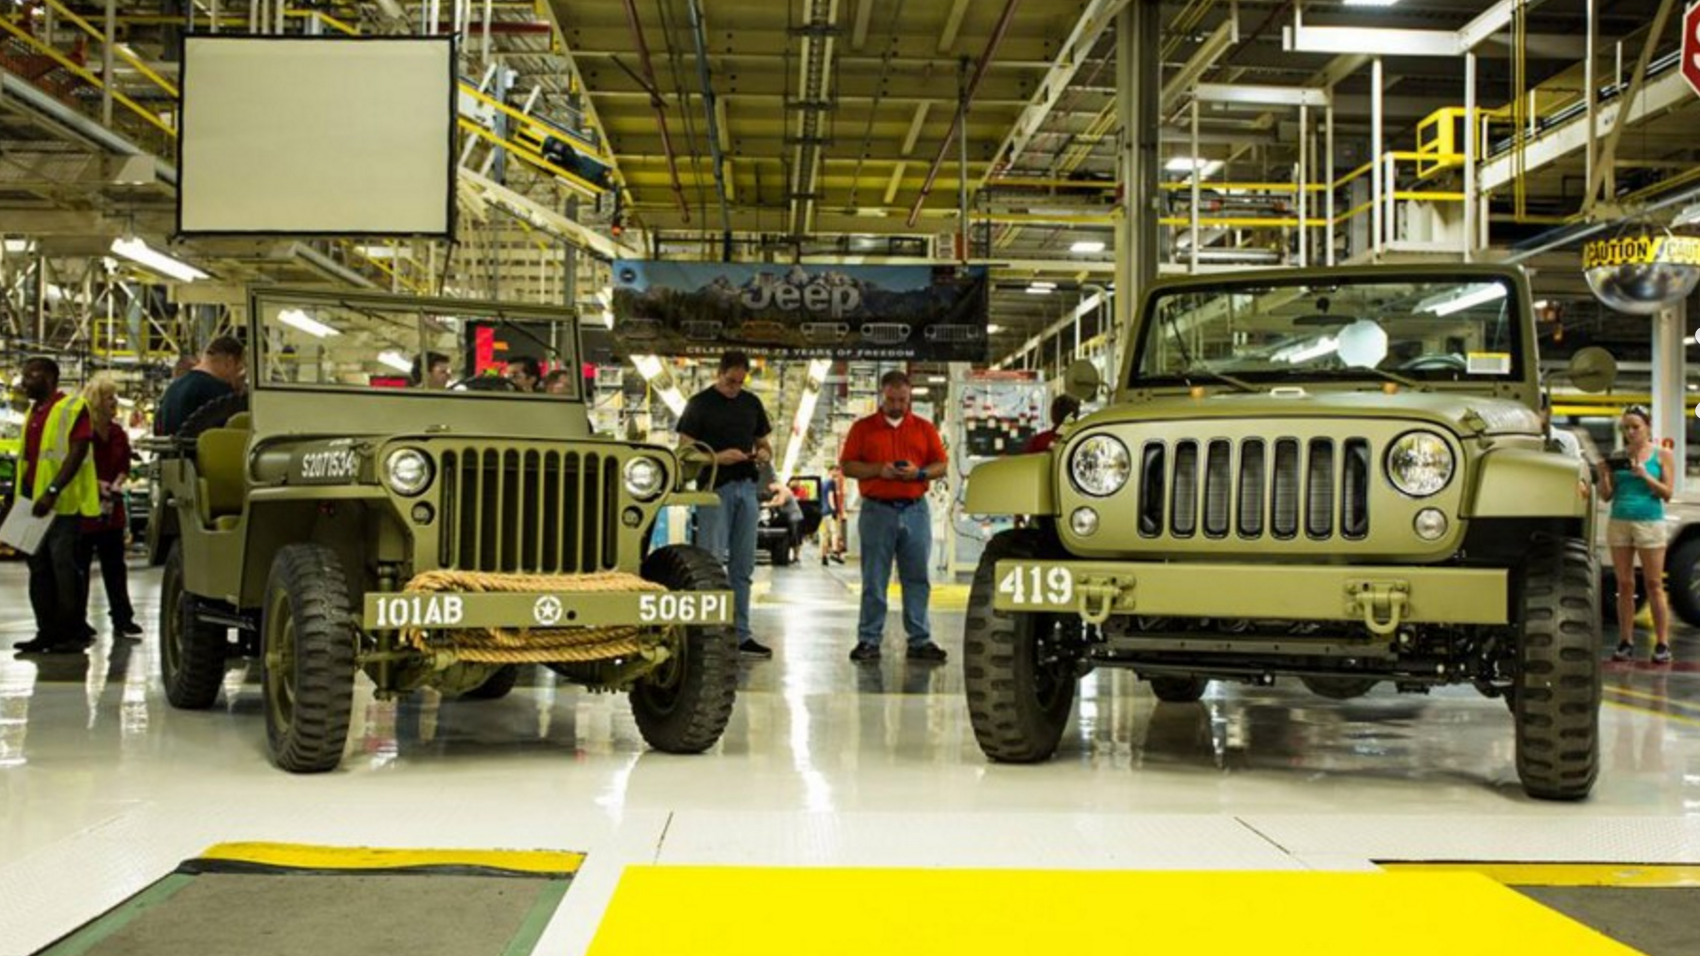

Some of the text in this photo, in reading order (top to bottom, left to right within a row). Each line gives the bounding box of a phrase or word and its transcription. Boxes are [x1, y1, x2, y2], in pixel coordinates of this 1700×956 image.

[743, 271, 860, 317] Jeep
[774, 348, 790, 357] 75
[793, 348, 833, 357] YEARS
[836, 349, 853, 357] OF
[856, 348, 915, 358] FREEDOM
[999, 566, 1073, 605] 419
[376, 595, 464, 627] 101AB
